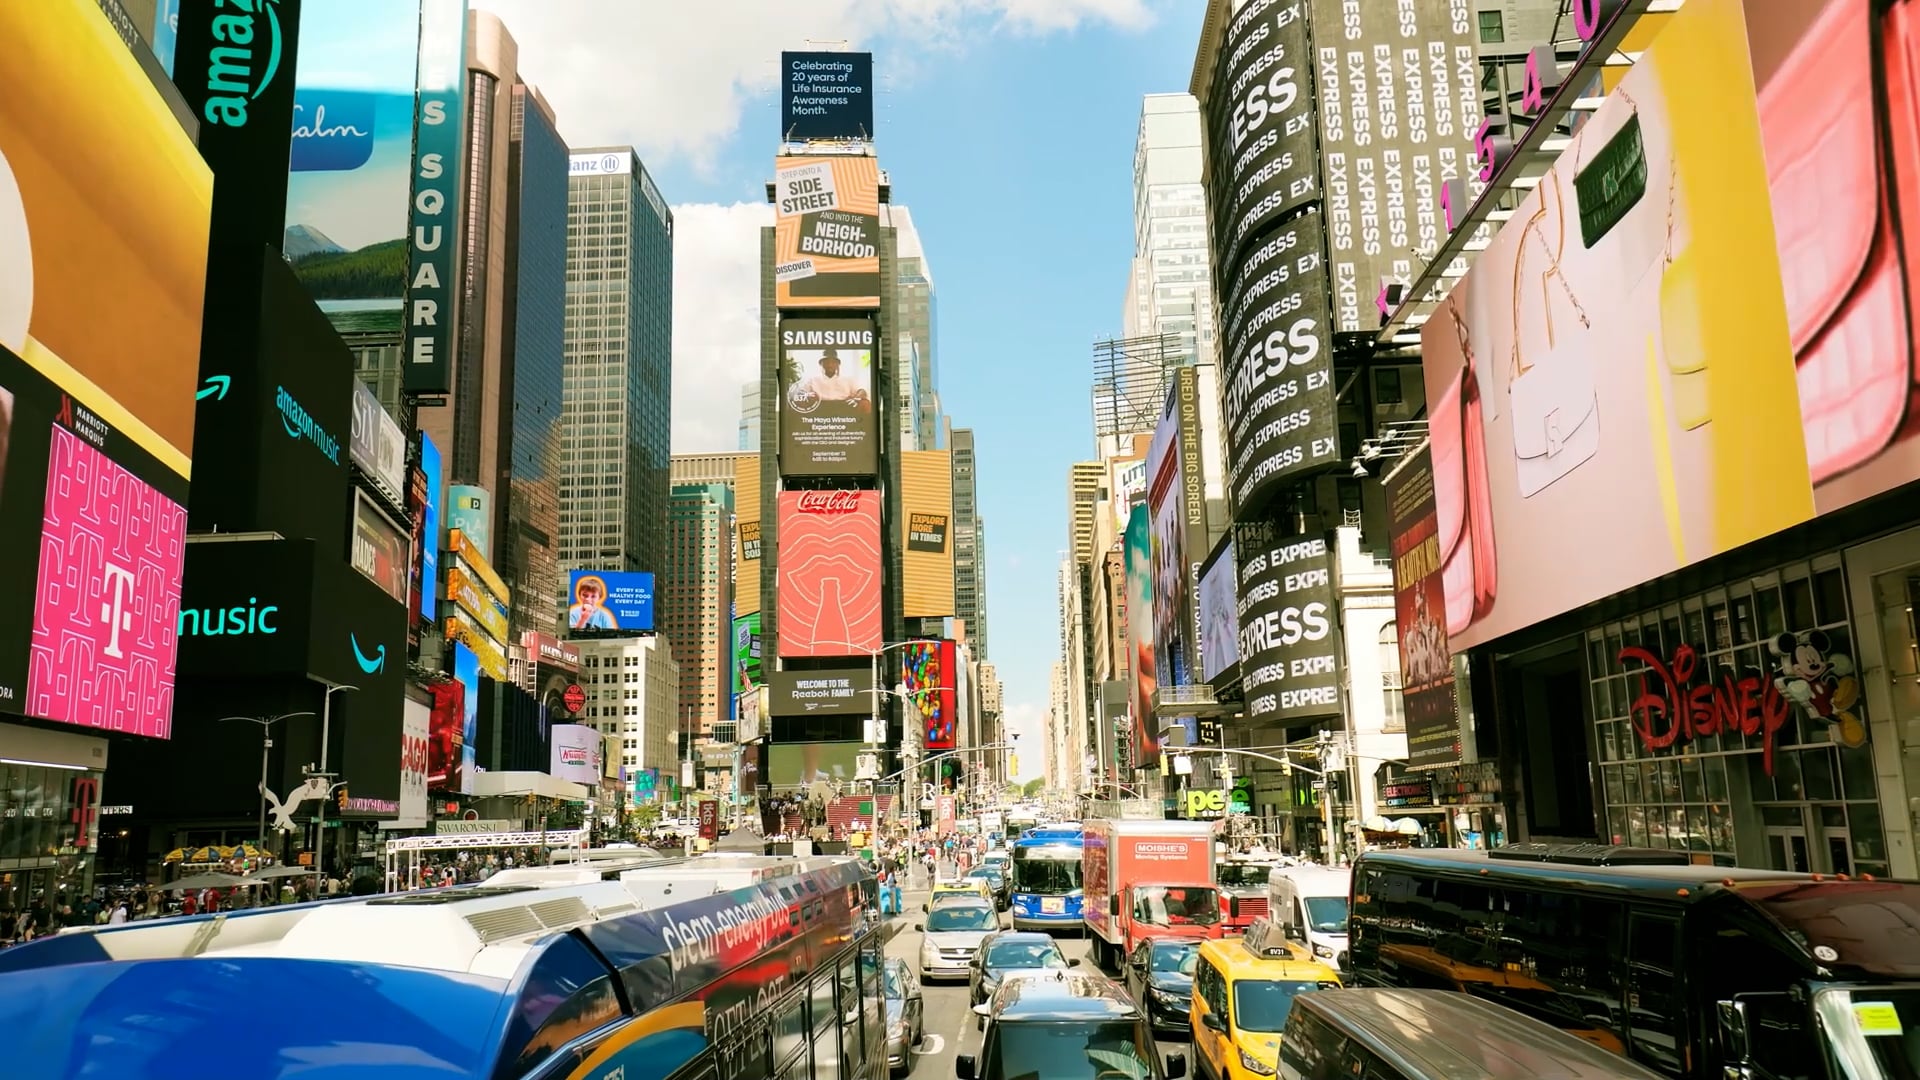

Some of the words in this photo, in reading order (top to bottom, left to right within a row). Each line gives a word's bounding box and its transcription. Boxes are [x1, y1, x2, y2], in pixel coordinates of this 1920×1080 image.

[792, 61, 853, 72] Celebrating
[792, 72, 805, 81] 20
[807, 73, 836, 83] years
[837, 73, 848, 81] of
[1232, 44, 1284, 101] EXPRESS
[792, 84, 811, 93] Life
[812, 84, 862, 93] Insurance
[792, 95, 848, 105] Awareness
[1320, 47, 1344, 142] EXPRESS
[1347, 52, 1371, 147] EXPRESS
[1374, 44, 1398, 140] EXPRESS
[1403, 48, 1428, 144] EXPRESS
[1428, 41, 1453, 137] EXPRESS
[792, 105, 827, 115] Month.
[1234, 129, 1278, 182] EXPRESS
[781, 170, 798, 179] STEP
[798, 167, 816, 176] ONTO
[789, 178, 822, 196] SIDE
[1239, 152, 1293, 204] EXPRESS
[782, 192, 834, 213] STREET
[1329, 152, 1353, 250] EXPRESS
[1357, 157, 1381, 256] EXPRESS
[1384, 149, 1408, 248] EXPRESS
[820, 211, 834, 220] AND
[835, 213, 850, 222] INTO
[851, 215, 863, 224] THE
[1238, 190, 1282, 239] EXPRESS
[815, 221, 866, 241] NEIGH-
[412, 154, 445, 364] SQUARE
[802, 236, 875, 258] BORHOOD
[1244, 231, 1297, 280] EXPRESS
[1243, 265, 1289, 312] EXPRESS
[1247, 292, 1302, 338] EXPRESS
[783, 331, 873, 345] SAMSUNG
[1226, 318, 1319, 432] EXPRESS
[1183, 404, 1195, 422] ON
[1250, 379, 1298, 420] EXPRESS
[76, 420, 104, 447] MARQUIS
[77, 406, 109, 436] MARRIOTT
[276, 385, 313, 440] amazon
[313, 423, 340, 466] music
[1255, 409, 1310, 448] EXPRESS
[1184, 425, 1197, 450] THE
[1186, 453, 1198, 473] BIG
[1254, 445, 1303, 484] EXPRESS
[797, 489, 860, 511] Coca-Cola
[1187, 477, 1201, 525] SCREEN
[911, 523, 934, 533] MORE
[912, 515, 945, 526] EXPLORE
[910, 531, 919, 541] IN
[920, 532, 942, 543] TIMES
[1240, 602, 1329, 664] EXPRESS
[792, 690, 830, 699] Reebok
[831, 688, 855, 698] FAMILY
[796, 680, 828, 689] WELCOME
[829, 679, 837, 688] TO
[838, 679, 850, 688] THE
[703, 803, 714, 825] tkts
[437, 823, 496, 834] SWAROVSKI
